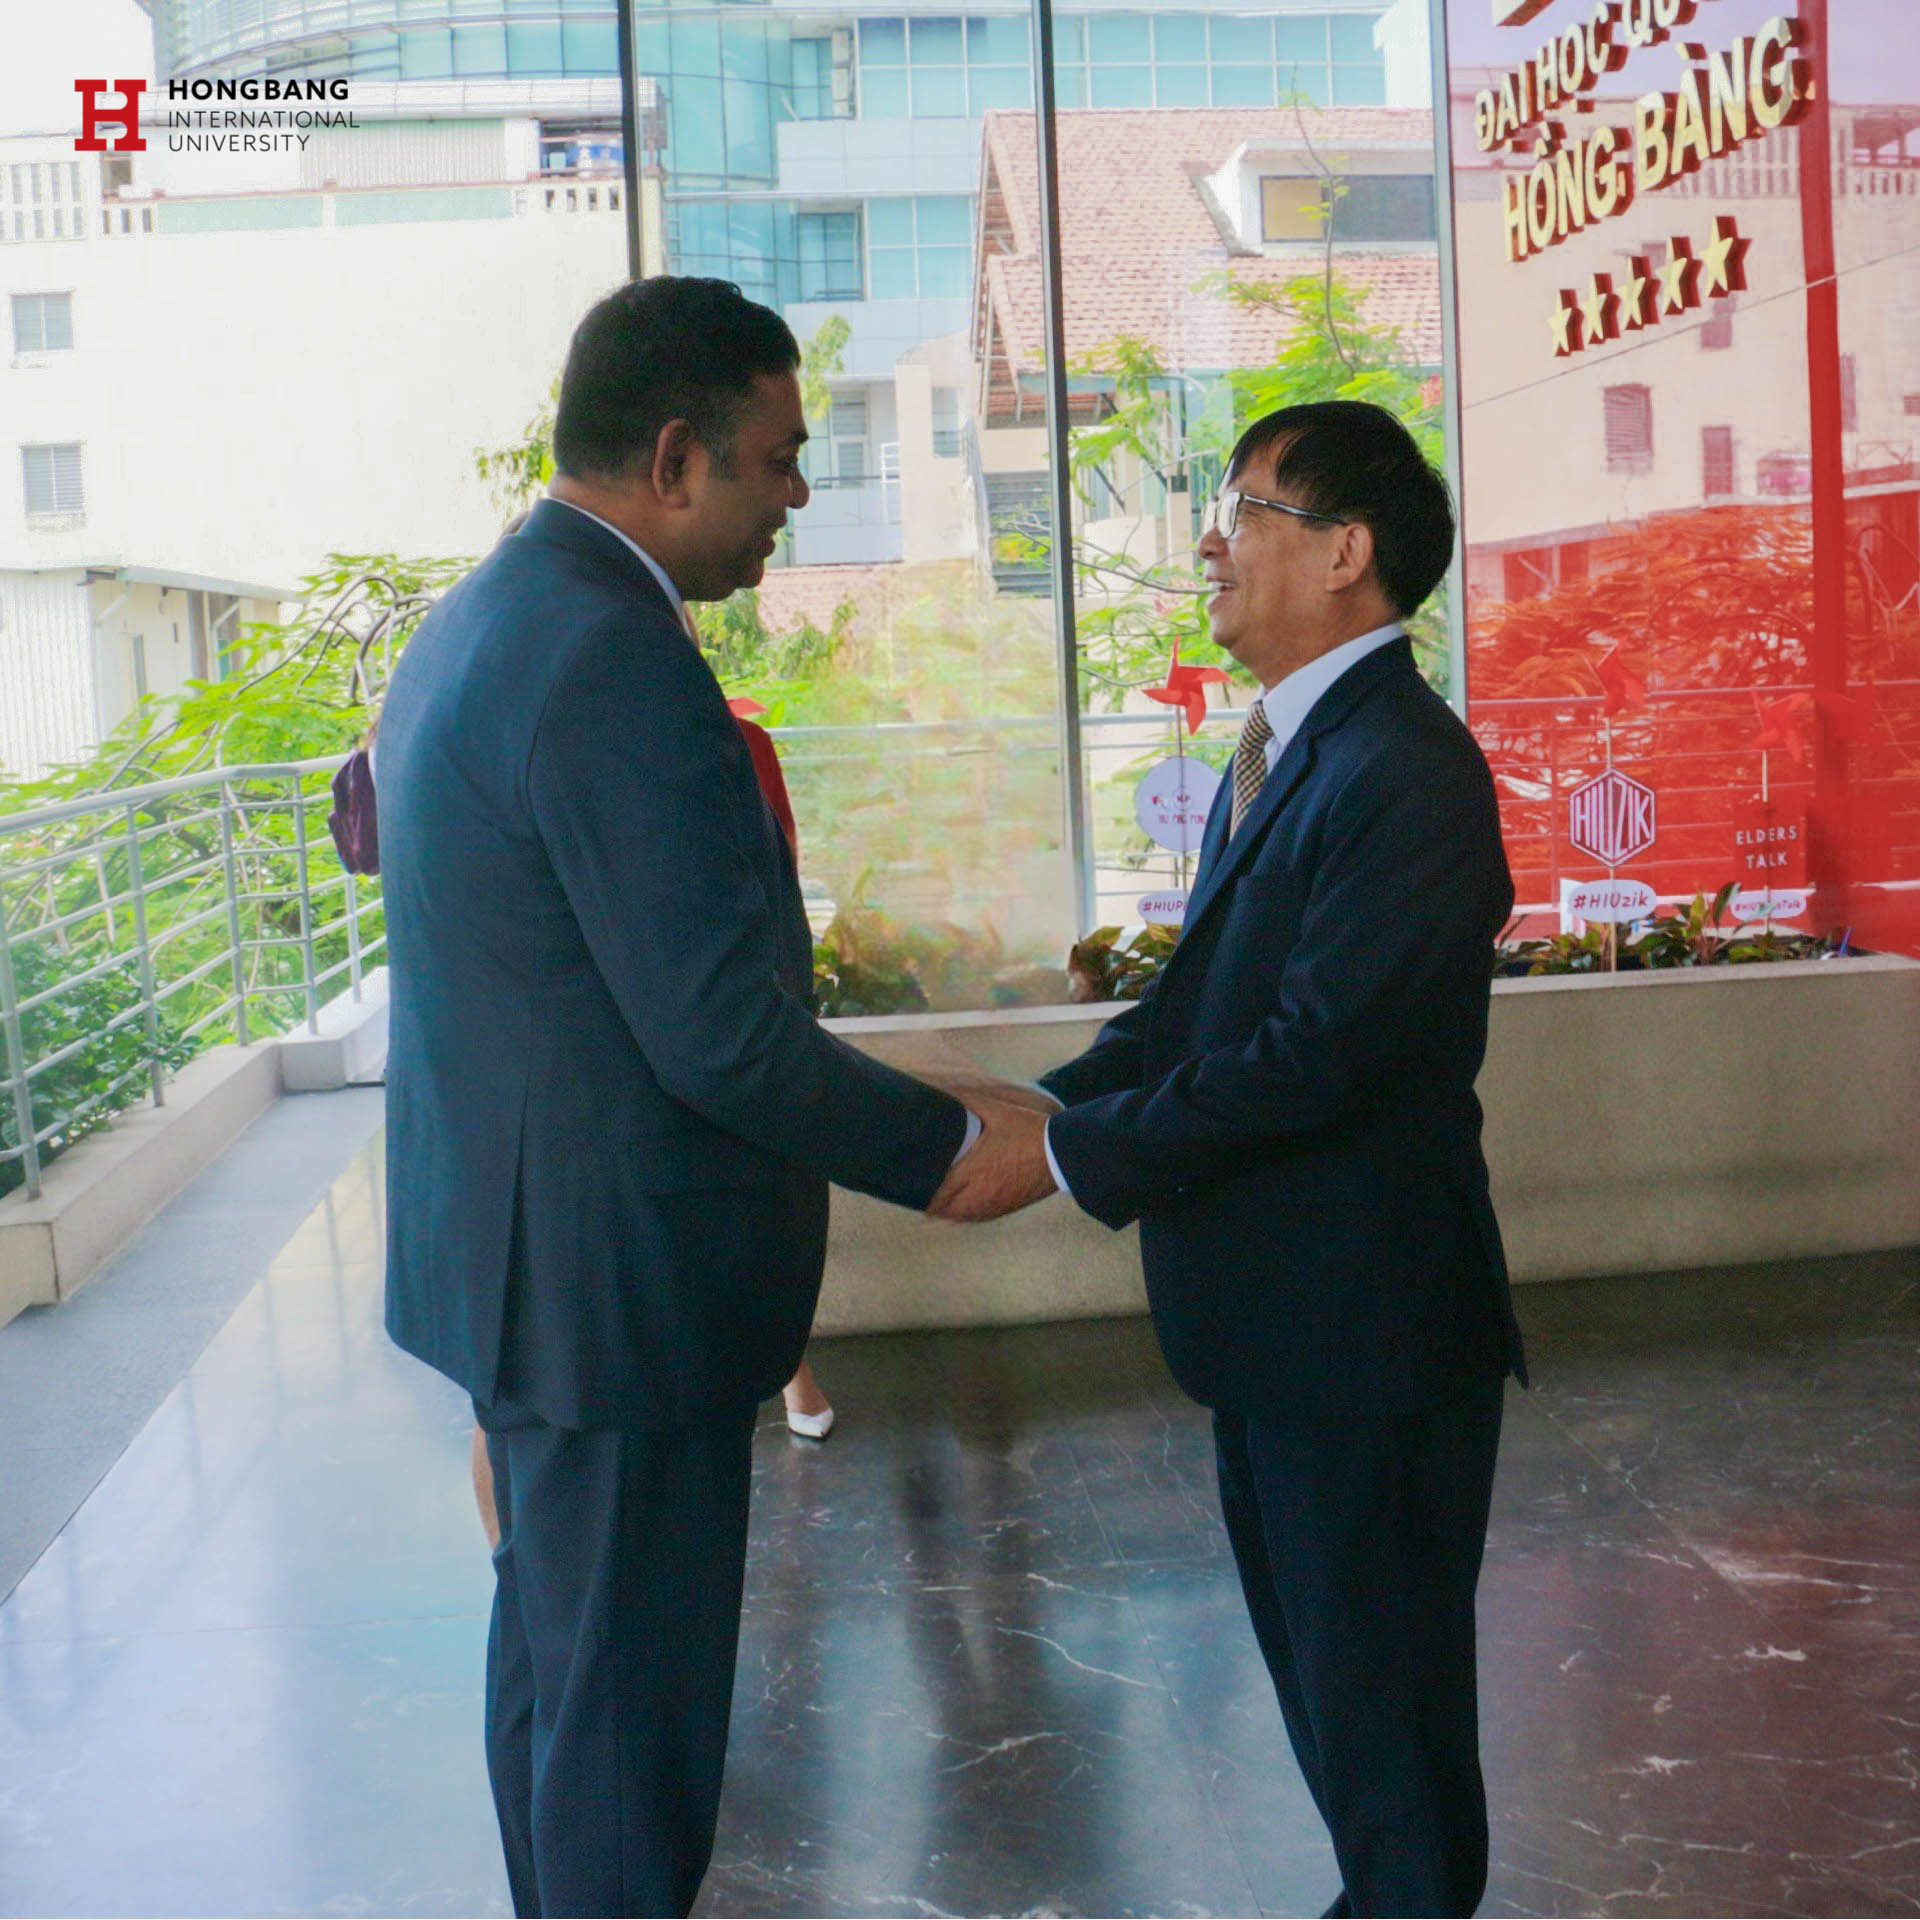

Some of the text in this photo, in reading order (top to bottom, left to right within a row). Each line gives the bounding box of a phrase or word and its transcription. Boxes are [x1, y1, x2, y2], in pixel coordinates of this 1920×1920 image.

[1475, 60, 1531, 153] ĐẠI
[1536, 2, 1611, 113] HỌC
[1502, 15, 1794, 262] HỒNG BÀNG
[1735, 824, 1798, 846] ELDERS
[1745, 850, 1788, 870] TALK
[1573, 889, 1649, 909] #HIUzik
